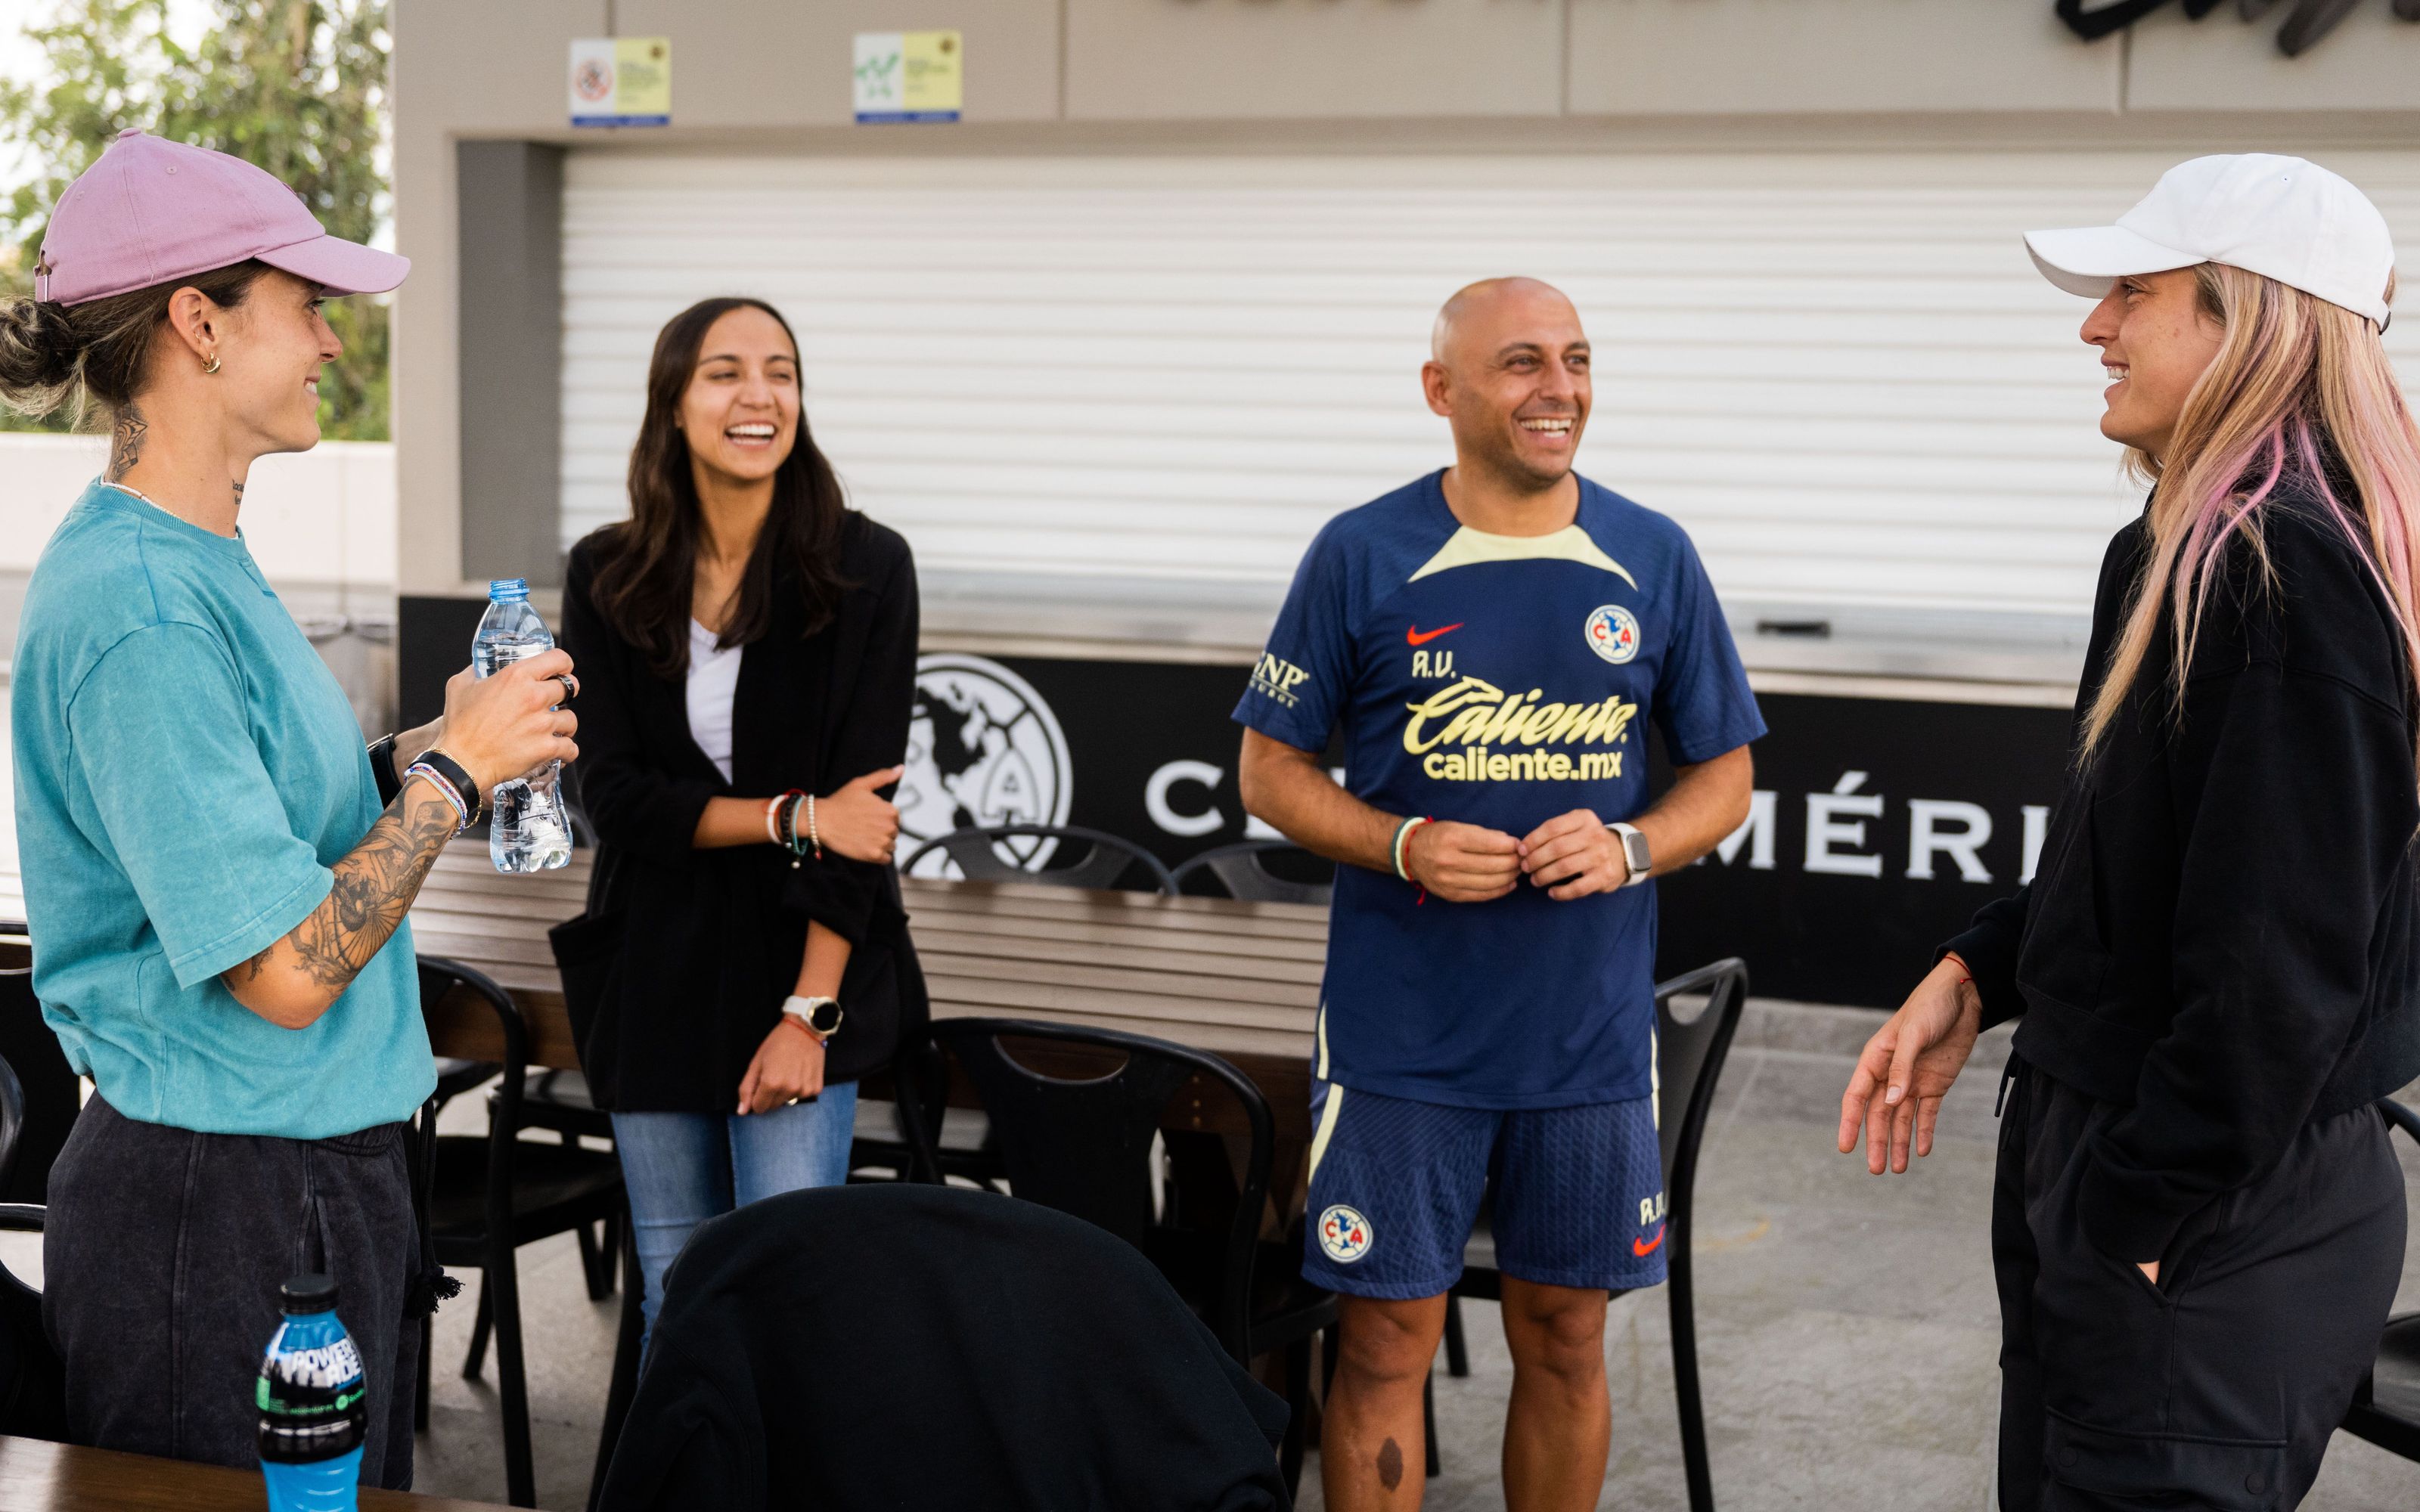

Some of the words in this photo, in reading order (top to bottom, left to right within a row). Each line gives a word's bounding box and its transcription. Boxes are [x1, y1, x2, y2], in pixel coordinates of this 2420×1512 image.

[1254, 651, 1305, 690] NP
[1403, 675, 1638, 755] Caliente
[1423, 746, 1623, 782] caliente.mx
[1691, 770, 2051, 887] MÉRI
[292, 1337, 355, 1371] POWER
